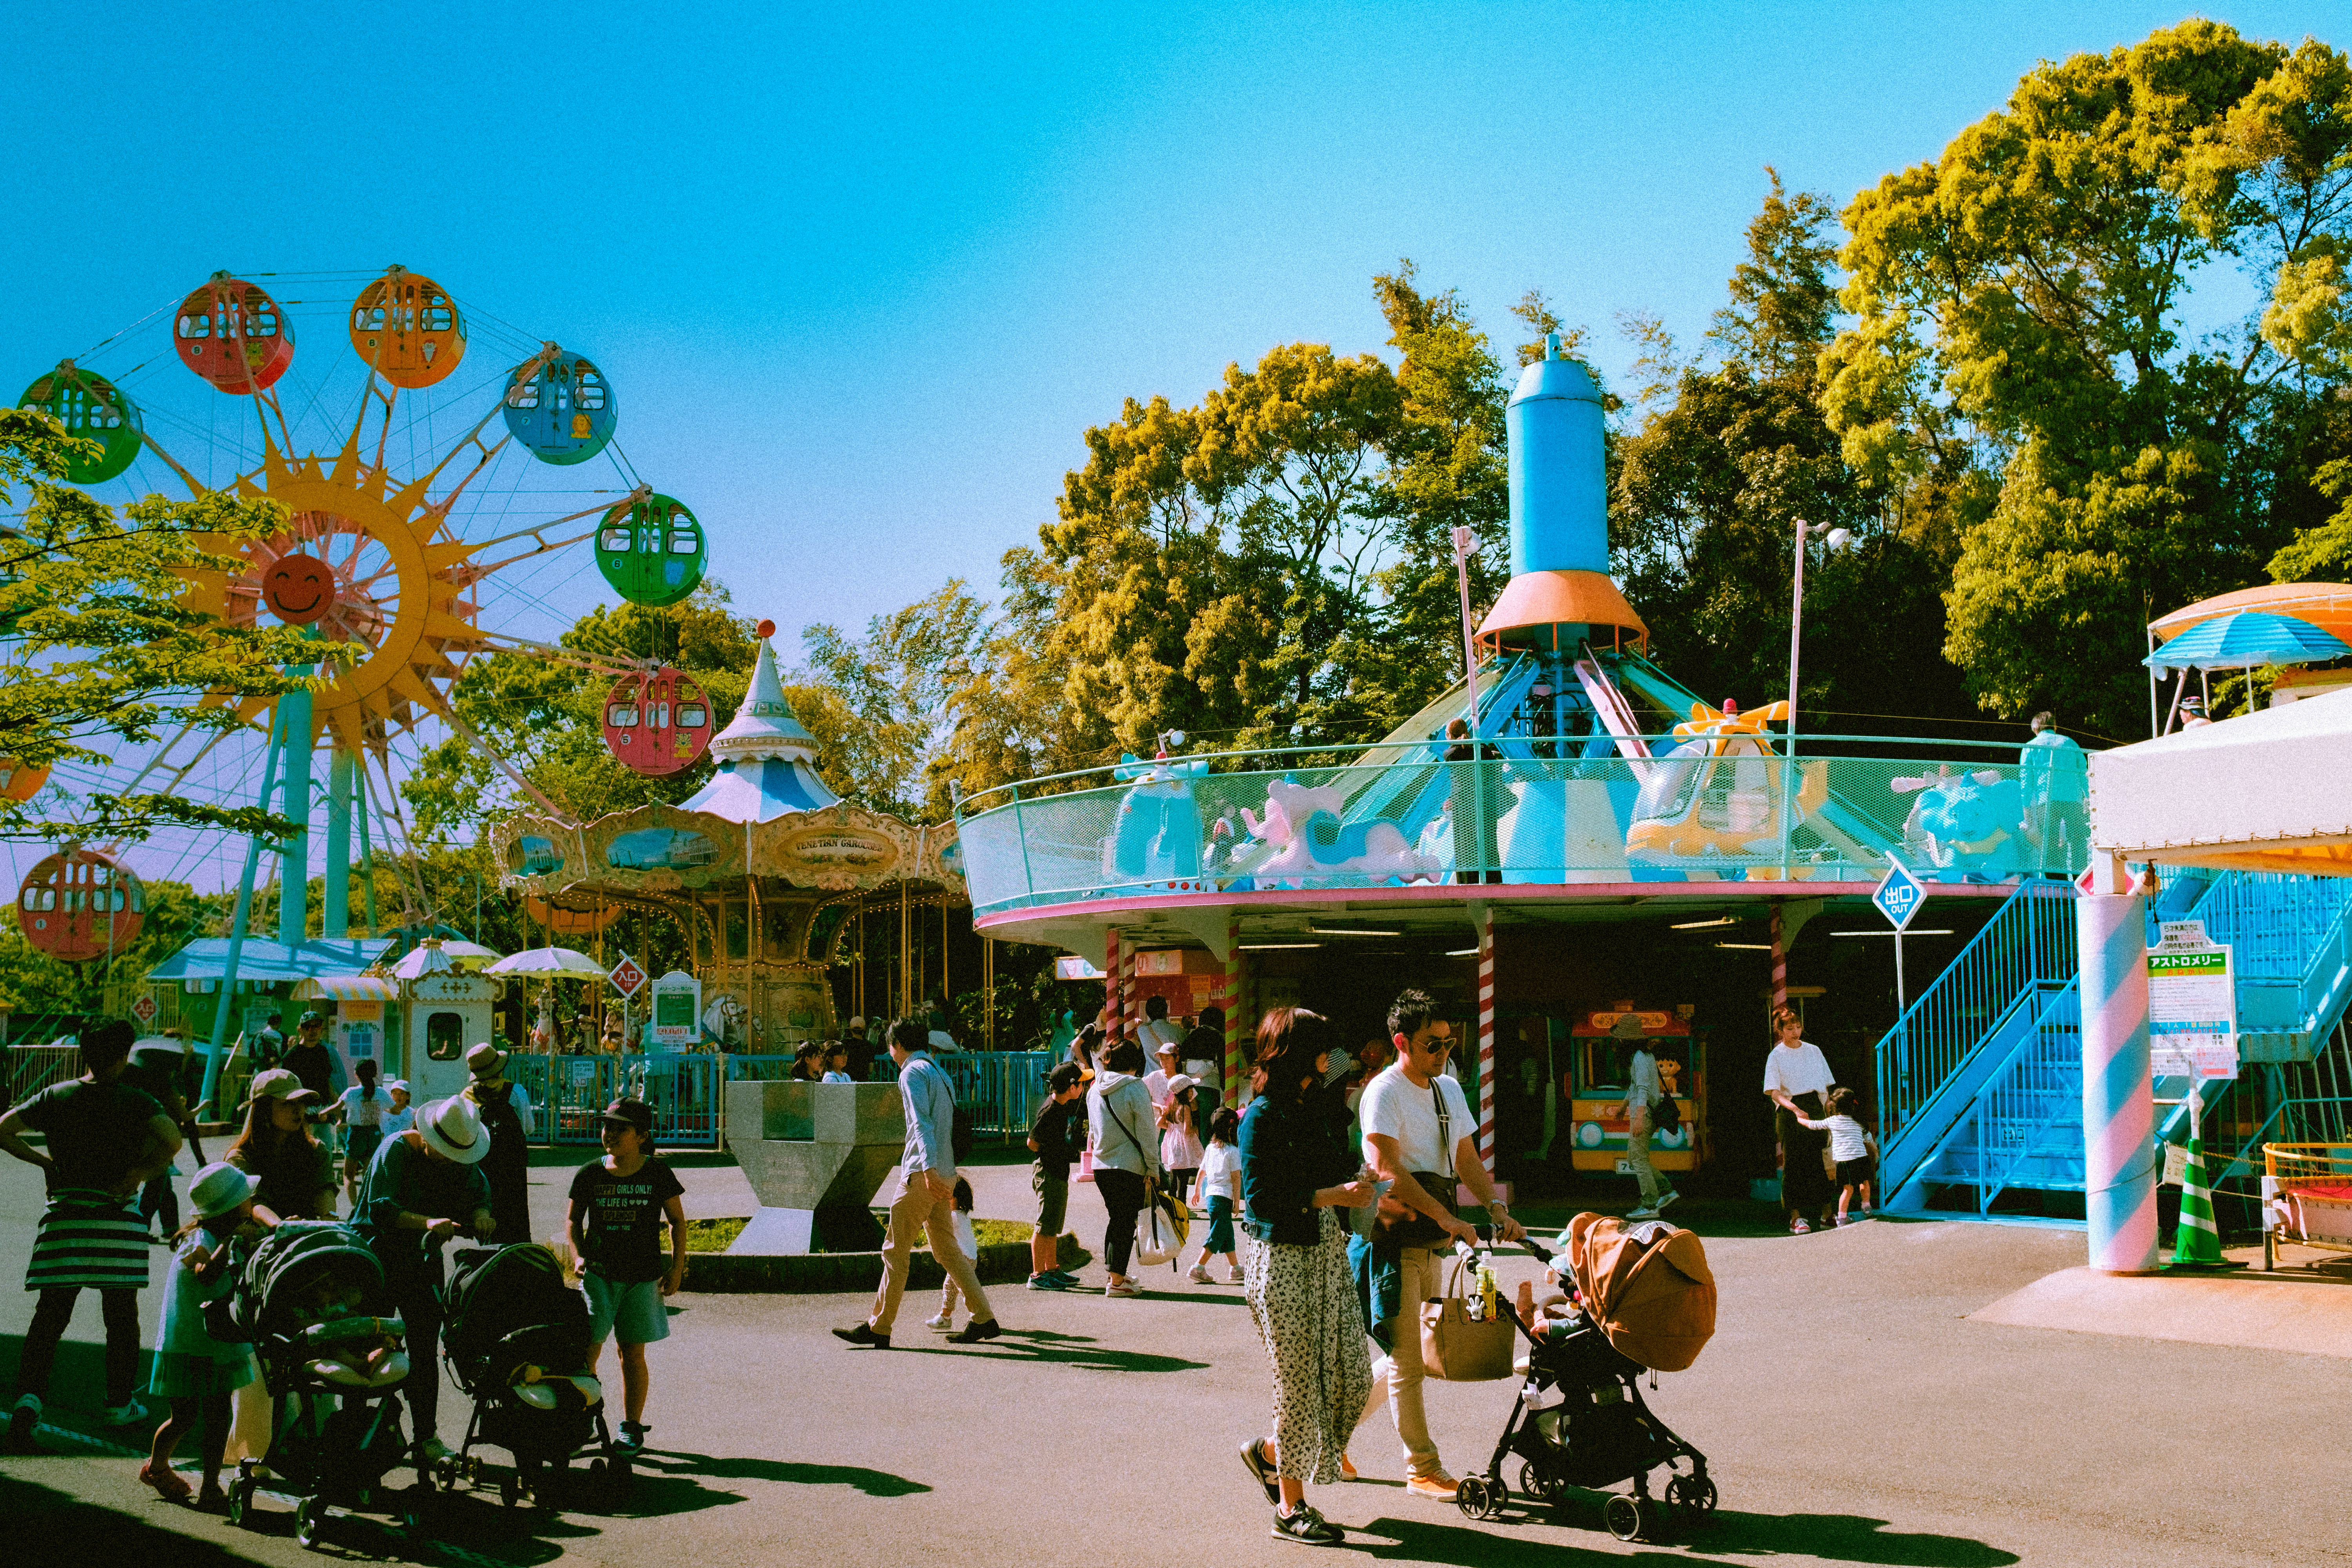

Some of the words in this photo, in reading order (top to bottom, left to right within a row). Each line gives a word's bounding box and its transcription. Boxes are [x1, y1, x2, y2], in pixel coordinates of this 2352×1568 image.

[796, 838, 838, 850] VENETIAN
[841, 839, 882, 852] CAROUSEL
[1885, 885, 1913, 905] 出口
[1891, 904, 1908, 914] OUT
[2151, 955, 2221, 967] アストロメリー
[617, 971, 637, 982] 入口
[137, 1003, 154, 1012] 入口
[199, 1003, 205, 1011] 2
[617, 1185, 634, 1194] GIRLS
[635, 1185, 652, 1194] ONLY!
[596, 1198, 606, 1207] THE
[607, 1198, 620, 1207] LIFE
[622, 1198, 628, 1207] IS
